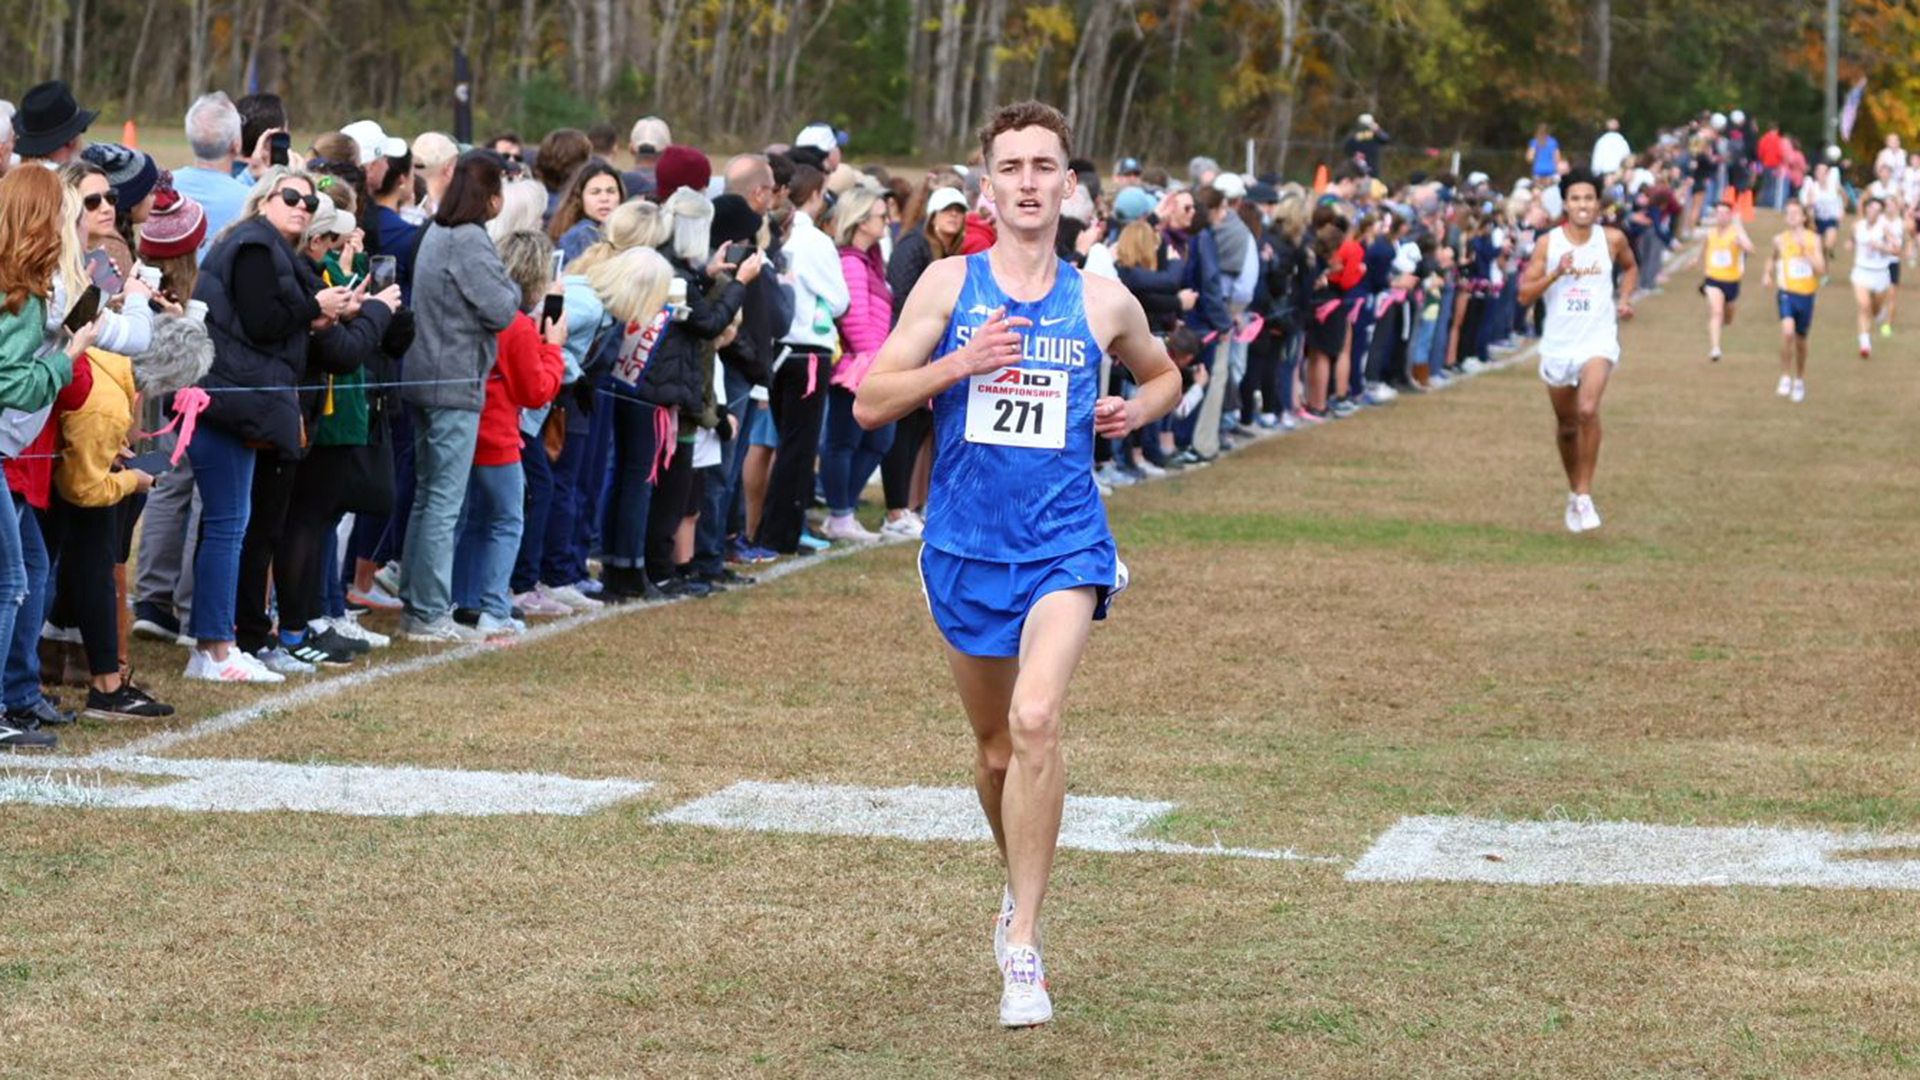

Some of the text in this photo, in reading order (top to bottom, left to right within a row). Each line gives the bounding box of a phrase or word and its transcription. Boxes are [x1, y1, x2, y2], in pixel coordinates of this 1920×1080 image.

[1023, 334, 1086, 367] LOUIS
[993, 369, 1051, 387] A10
[977, 384, 1061, 398] CHAMPIONSHIPS
[993, 399, 1044, 435] 271
